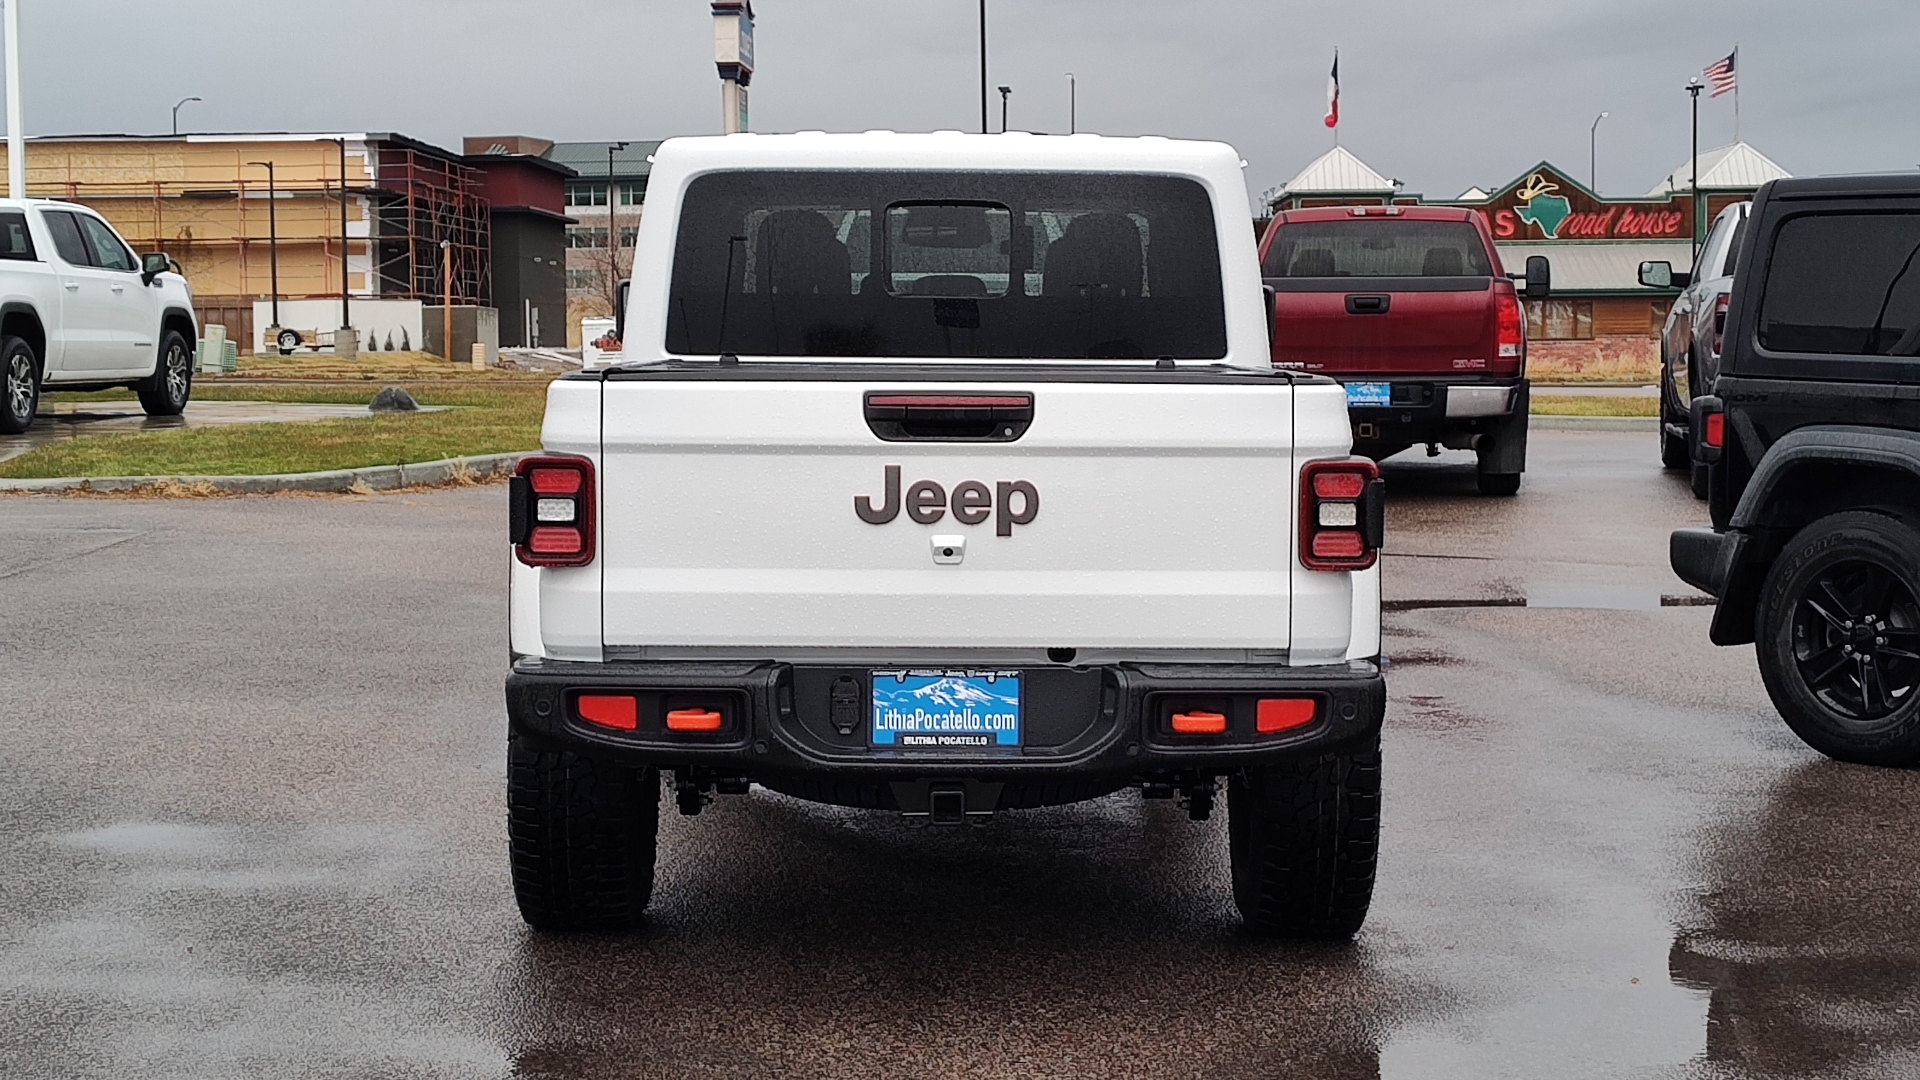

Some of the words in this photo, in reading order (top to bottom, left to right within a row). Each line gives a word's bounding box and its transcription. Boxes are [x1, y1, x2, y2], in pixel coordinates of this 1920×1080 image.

[854, 465, 1039, 537] Jeep
[875, 707, 1015, 730] LithiaPocatello.com
[938, 736, 988, 745] POCATELLO
